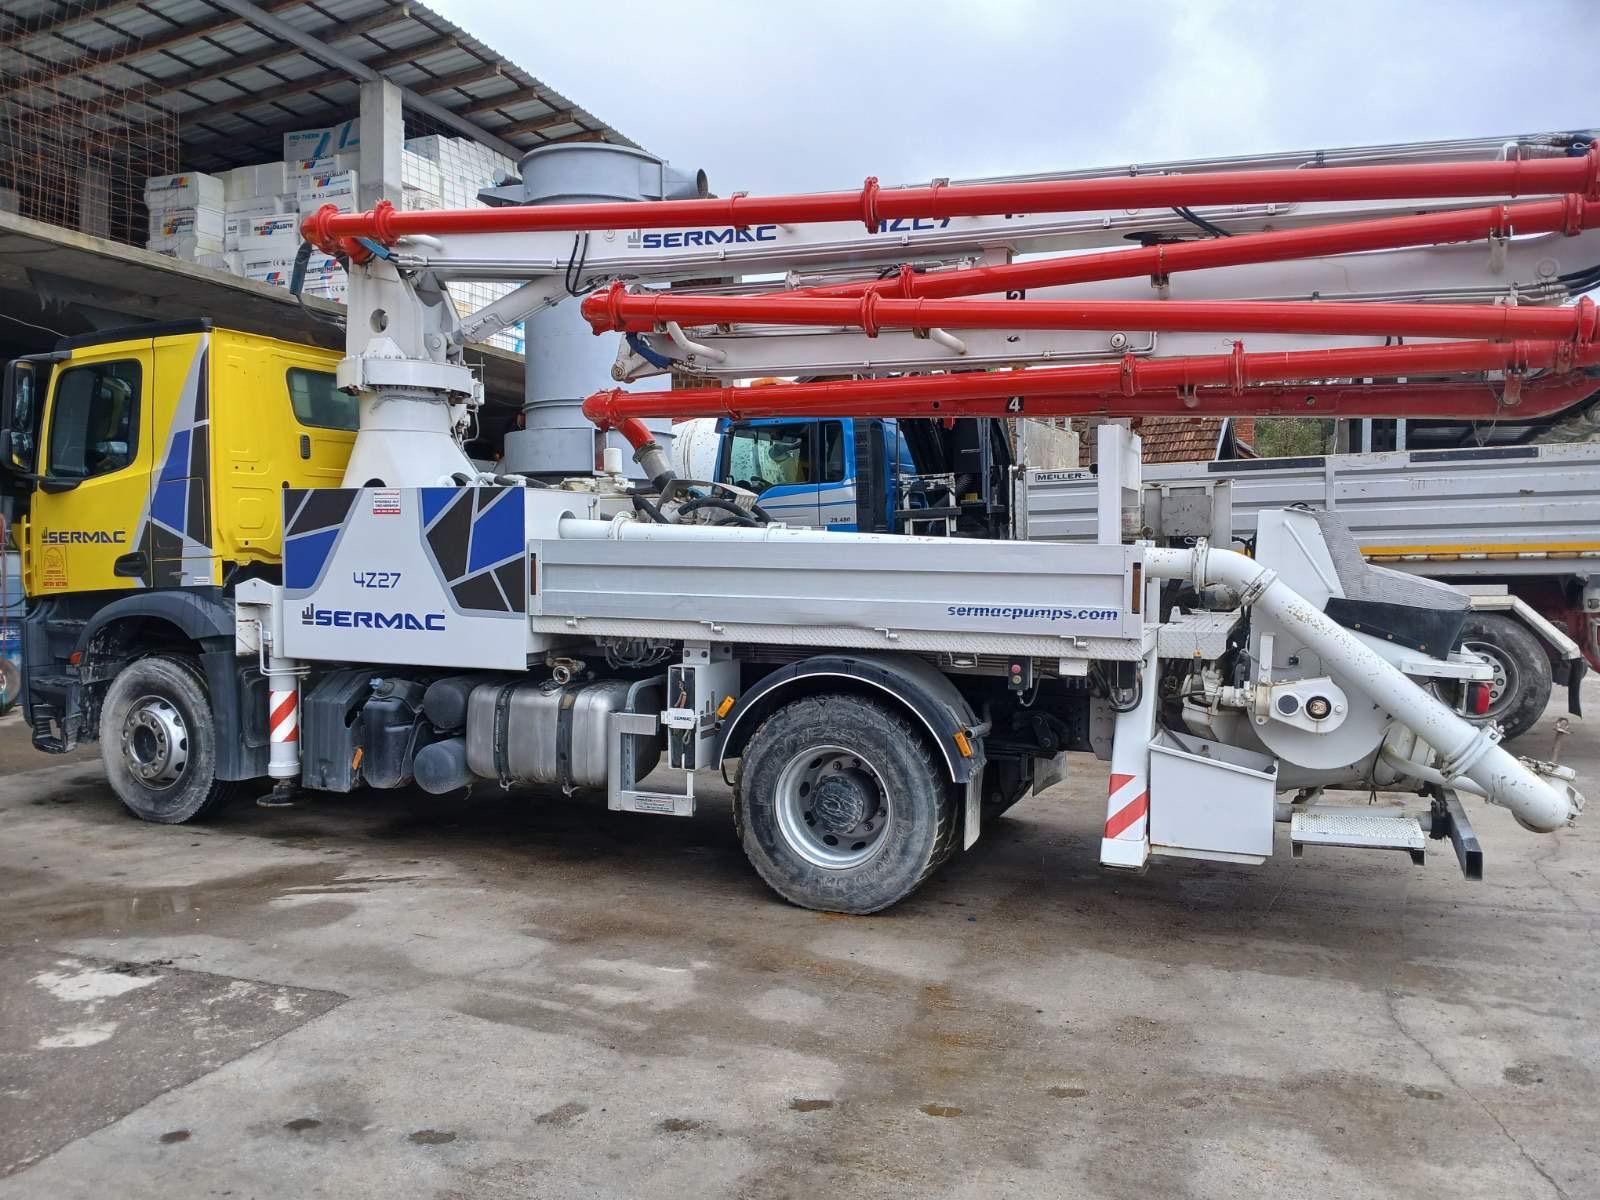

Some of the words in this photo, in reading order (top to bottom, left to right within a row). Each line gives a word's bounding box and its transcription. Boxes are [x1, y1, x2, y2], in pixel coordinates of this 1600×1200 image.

[643, 225, 777, 249] SERMAC
[1008, 396, 1021, 412] 4
[48, 530, 126, 544] SERMAC
[353, 571, 401, 588] 4Z27
[315, 609, 446, 631] SERMAC
[947, 606, 1118, 621] sermacpumps.com
